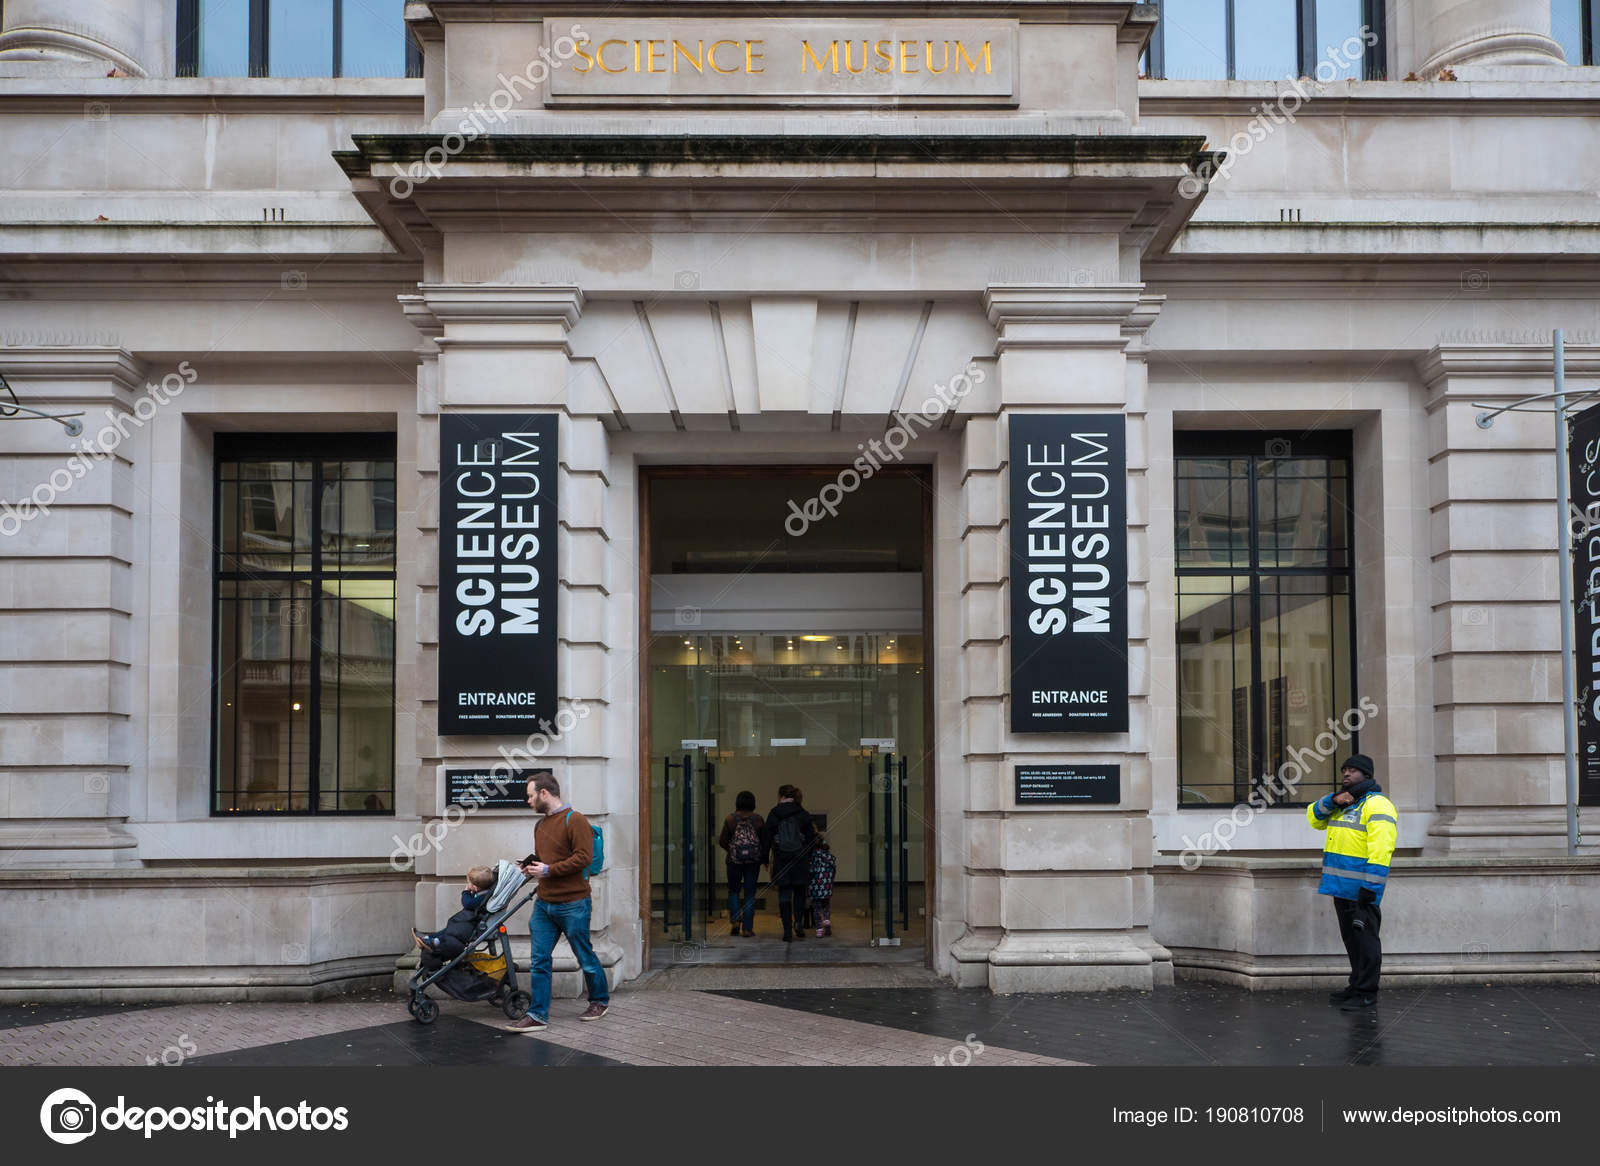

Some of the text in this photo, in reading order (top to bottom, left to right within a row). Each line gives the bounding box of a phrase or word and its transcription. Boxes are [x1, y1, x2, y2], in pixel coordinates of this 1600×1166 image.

[573, 39, 992, 74] SCIENCE MUSEUM
[456, 443, 496, 637] SCIENCE
[500, 432, 540, 635] MUSEUM
[1027, 443, 1067, 636] SCIENCE
[1071, 433, 1110, 633] MUSEUM
[458, 692, 536, 706] ENTRANCE
[1031, 690, 1108, 704] ENTRANCE
